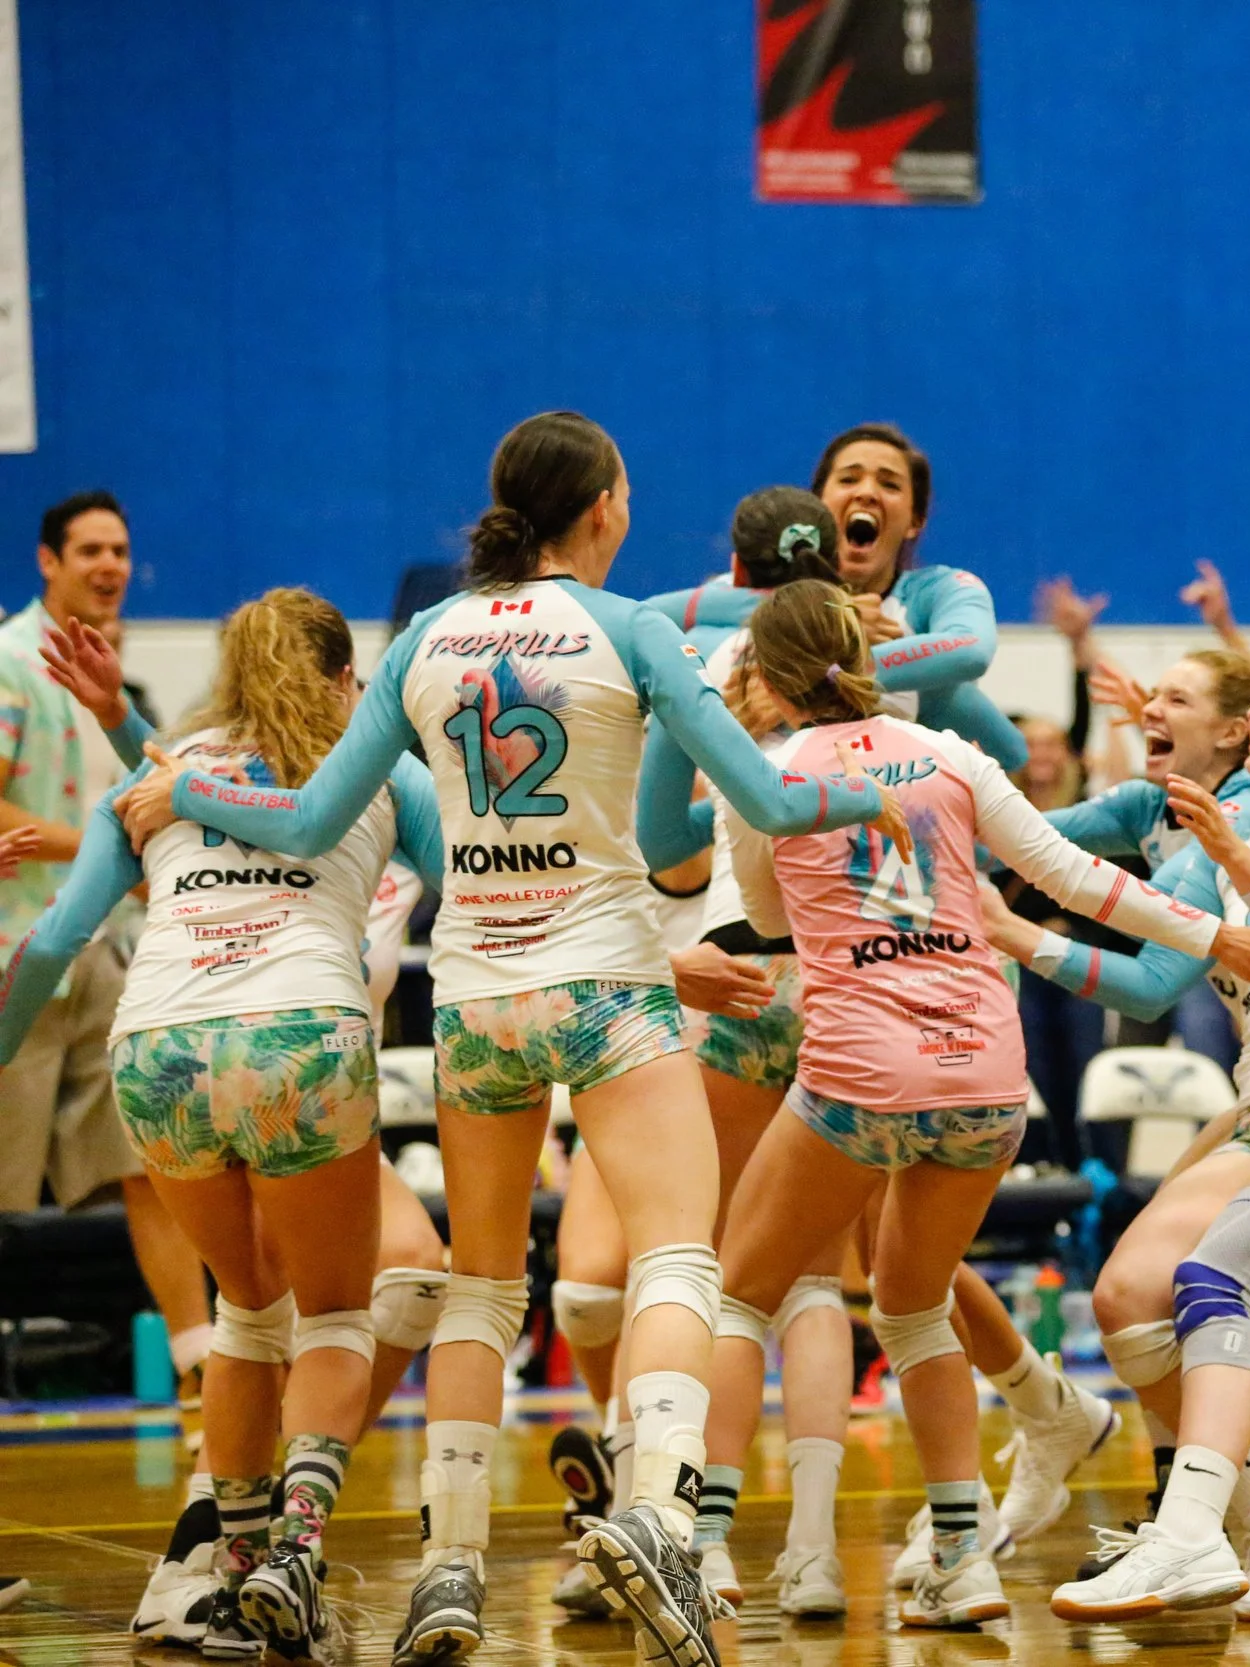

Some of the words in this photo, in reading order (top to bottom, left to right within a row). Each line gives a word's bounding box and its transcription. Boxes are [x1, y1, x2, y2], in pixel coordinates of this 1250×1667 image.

[426, 630, 590, 659] TROPIKILLS
[880, 635, 979, 669] VOLLEYBALL
[443, 703, 568, 817] 12
[188, 779, 215, 797] ONE
[217, 789, 300, 811] VOLLEYBAL
[452, 841, 576, 875] KONNO
[173, 868, 316, 895] KONNO
[455, 893, 484, 905] ONE
[485, 885, 582, 905] VOLLEYBAL
[193, 920, 280, 937] TimberTown
[850, 933, 971, 970] KONNO
[326, 1035, 360, 1048] FLEO
